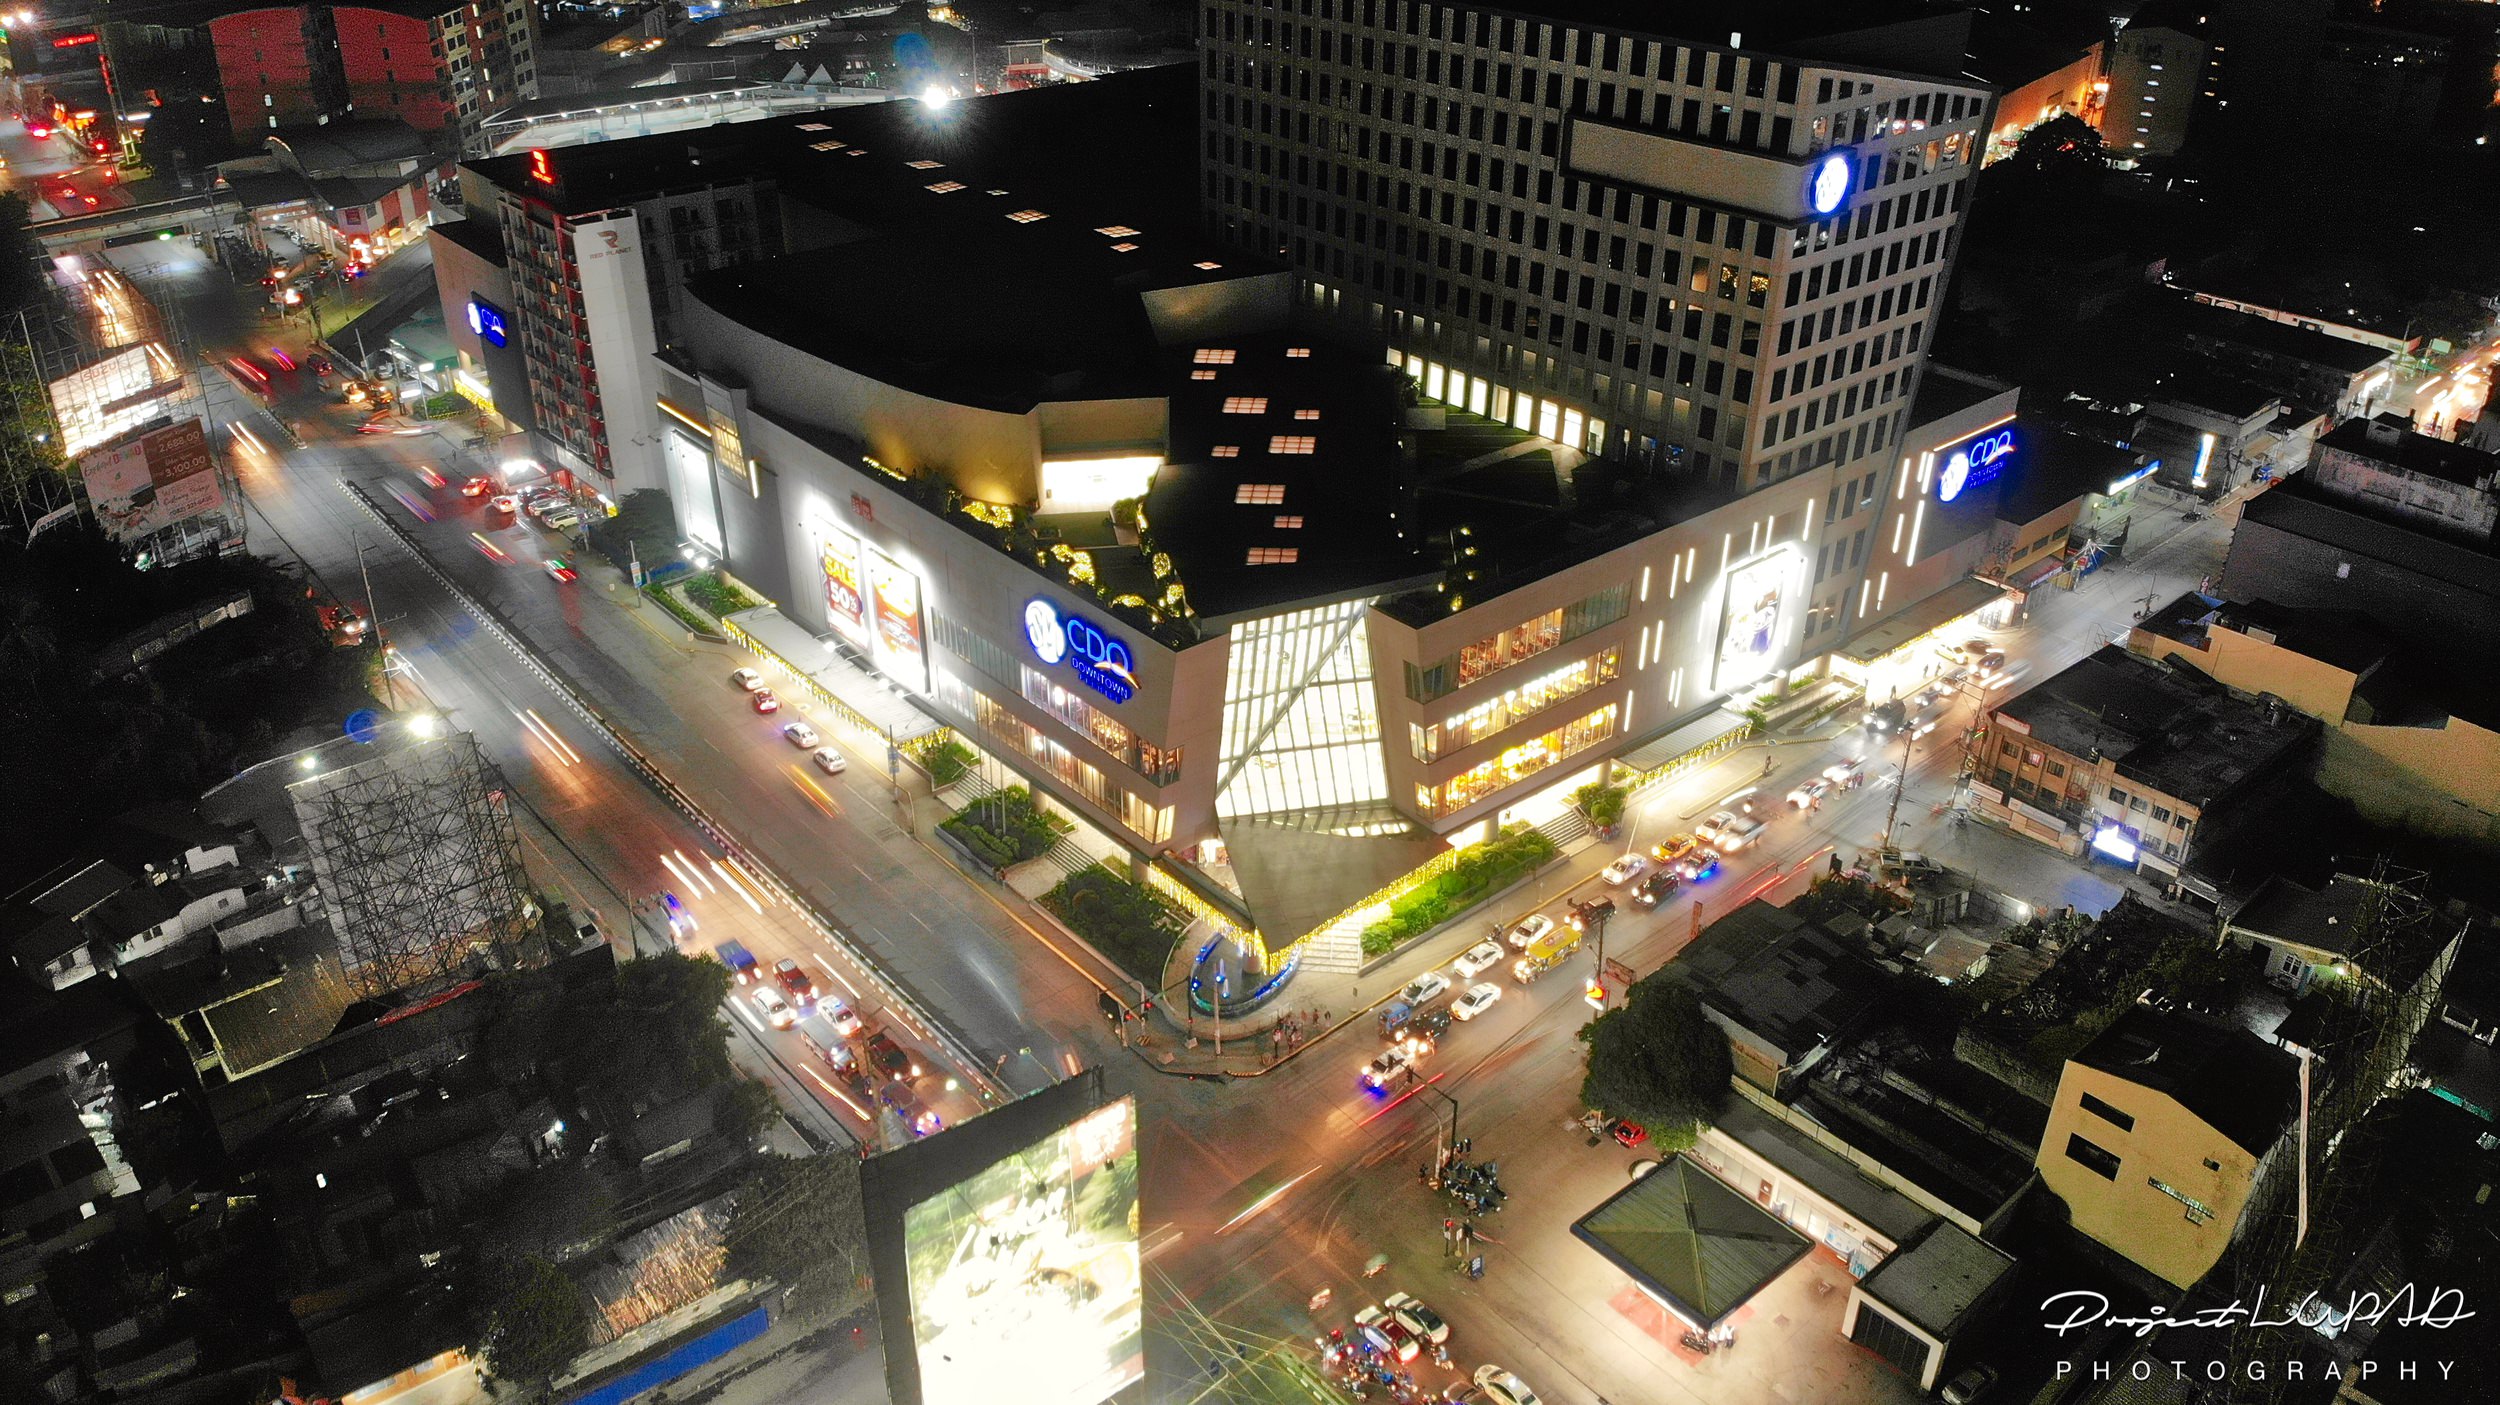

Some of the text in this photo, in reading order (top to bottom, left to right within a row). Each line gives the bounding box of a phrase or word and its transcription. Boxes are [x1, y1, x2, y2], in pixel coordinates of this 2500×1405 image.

[823, 554, 857, 588] SALE
[829, 579, 859, 614] 50%
[1072, 657, 1128, 699] DOWNTOWN
